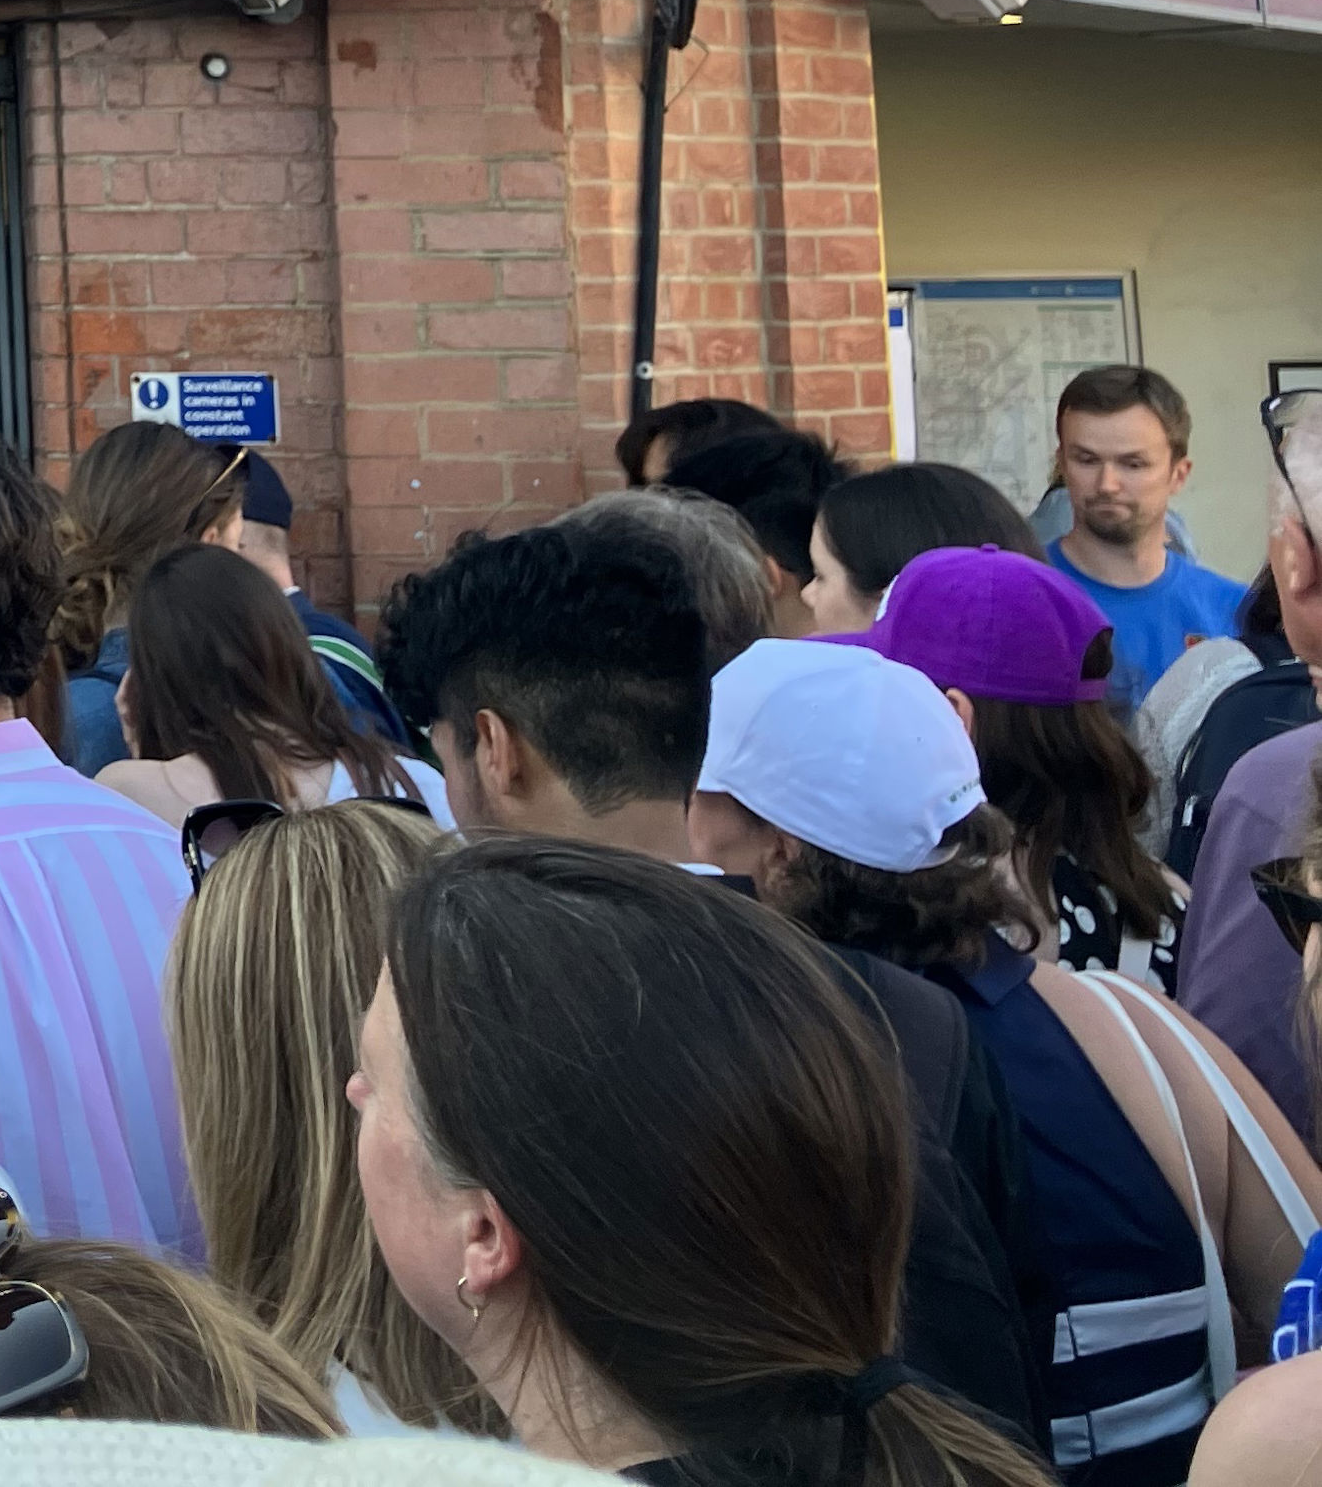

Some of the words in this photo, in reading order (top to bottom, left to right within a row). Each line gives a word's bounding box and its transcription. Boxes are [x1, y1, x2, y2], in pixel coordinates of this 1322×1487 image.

[183, 379, 263, 393] Surveillance
[183, 395, 239, 407] cameras
[241, 394, 256, 407] in
[184, 409, 244, 422] constant
[184, 423, 251, 438] operation
